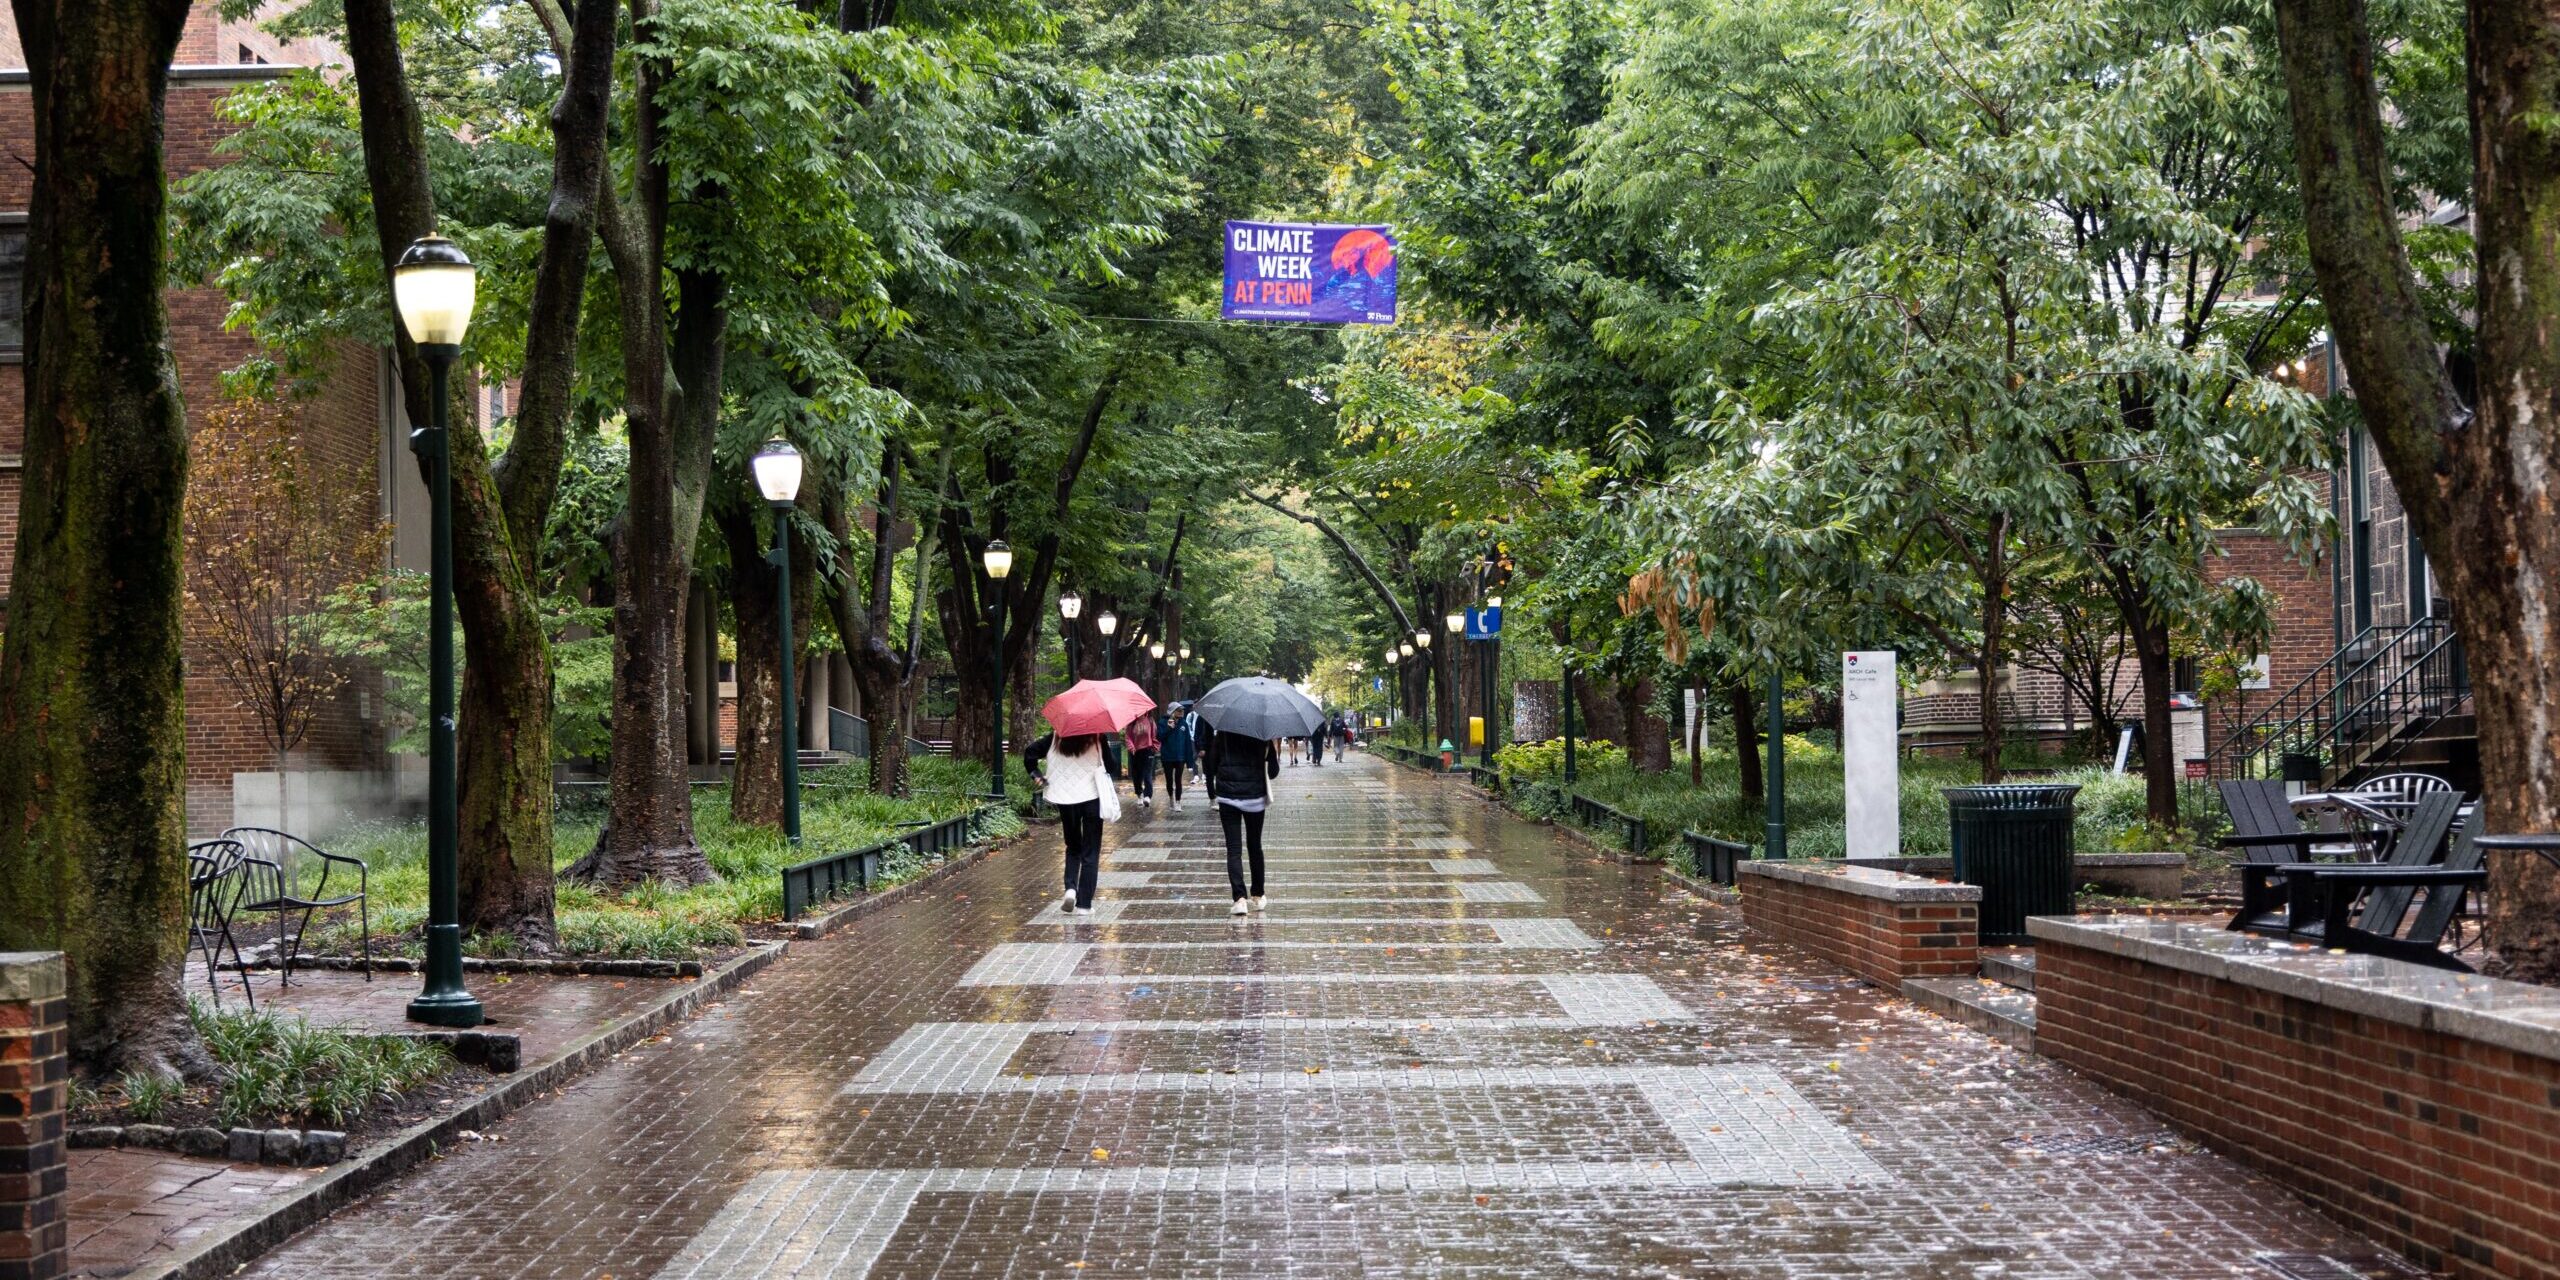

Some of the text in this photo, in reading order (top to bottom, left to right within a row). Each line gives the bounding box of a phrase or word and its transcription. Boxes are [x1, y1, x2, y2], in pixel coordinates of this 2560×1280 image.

[1233, 228, 1314, 254] CLIMATE
[1257, 255, 1313, 279] WEEK
[1234, 280, 1312, 305] AT PENN
[1375, 312, 1393, 321] Penn
